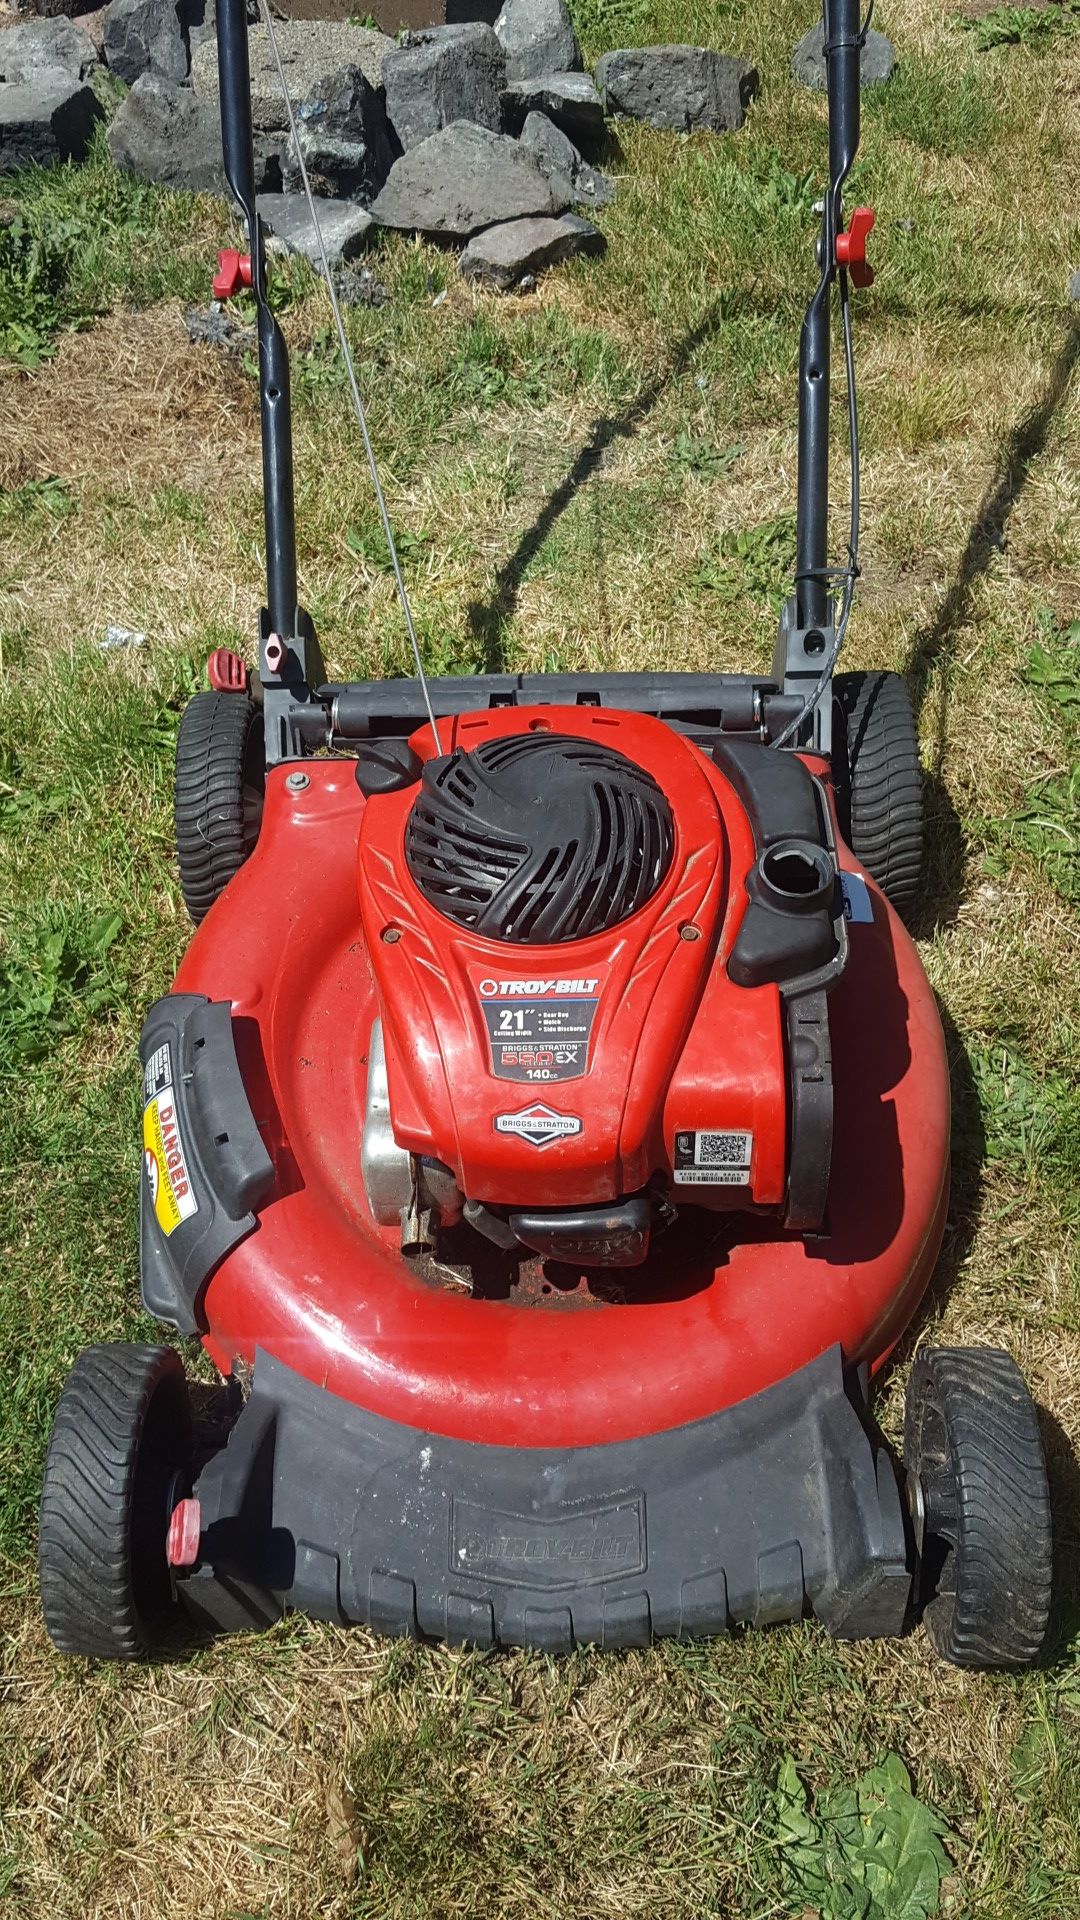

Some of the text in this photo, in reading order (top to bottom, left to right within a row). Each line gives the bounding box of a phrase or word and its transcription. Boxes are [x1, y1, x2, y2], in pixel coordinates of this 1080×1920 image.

[498, 979, 599, 994] TROY-BILT
[153, 1124, 163, 1156] HANDS
[161, 1172, 172, 1192] FEET
[168, 1192, 181, 1220] AWAY
[159, 1105, 189, 1200] DANGER
